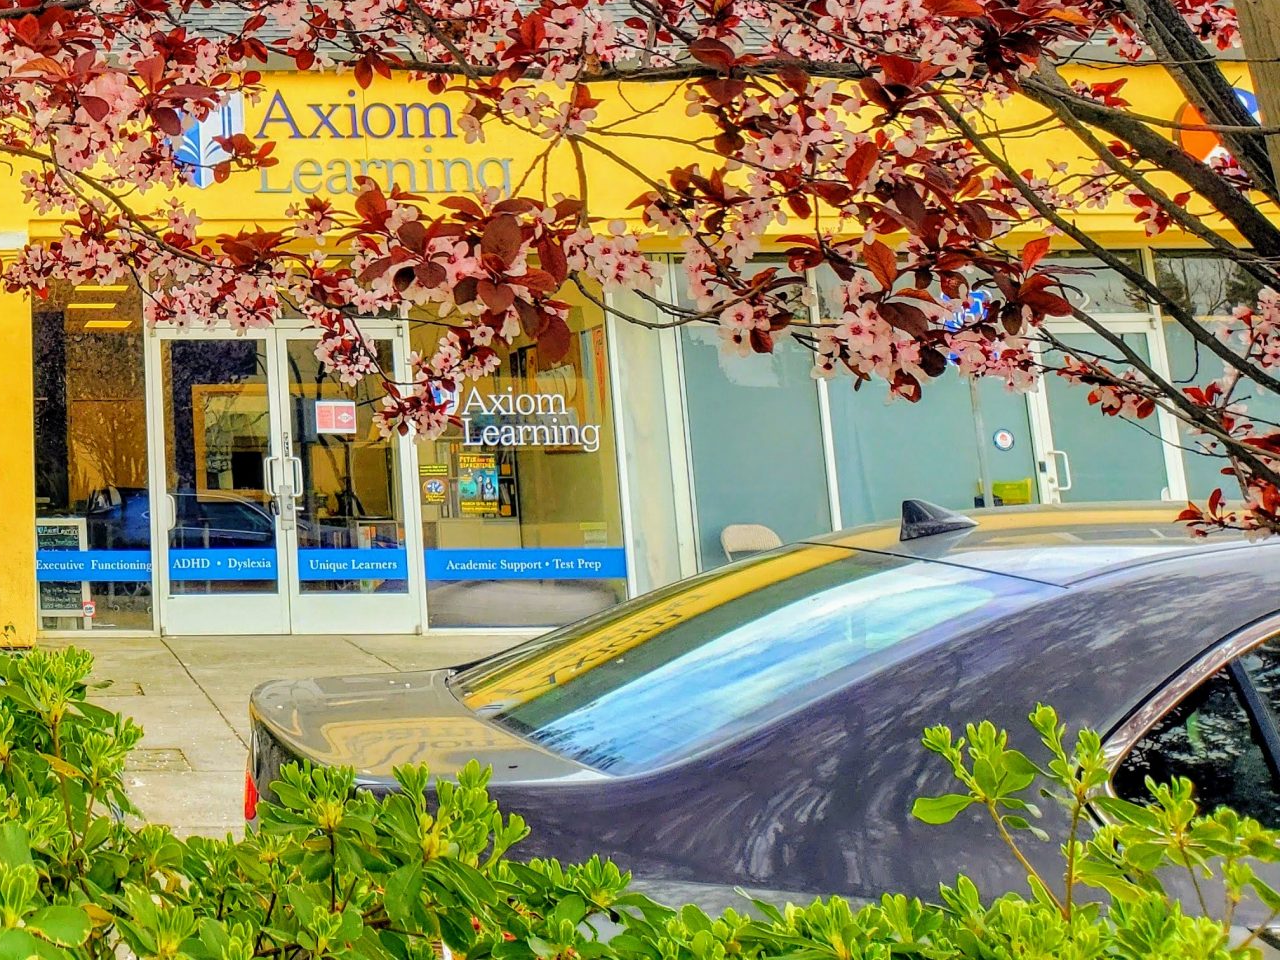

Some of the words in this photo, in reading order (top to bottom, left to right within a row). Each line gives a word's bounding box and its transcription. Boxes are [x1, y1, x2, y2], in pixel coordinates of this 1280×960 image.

[253, 88, 458, 139] Axiom
[254, 145, 514, 200] Learning
[461, 386, 568, 415] Axiom
[461, 417, 601, 452] Learning
[36, 559, 85, 571] Executive
[91, 559, 152, 572] Functioning
[173, 558, 210, 569] ADHD
[228, 558, 272, 571] Dyslexia
[309, 559, 348, 572] Unique
[352, 559, 398, 570] Learners
[446, 559, 496, 570] Academic
[500, 559, 542, 572] Support
[553, 559, 575, 570] Test
[577, 559, 602, 572] Prep
